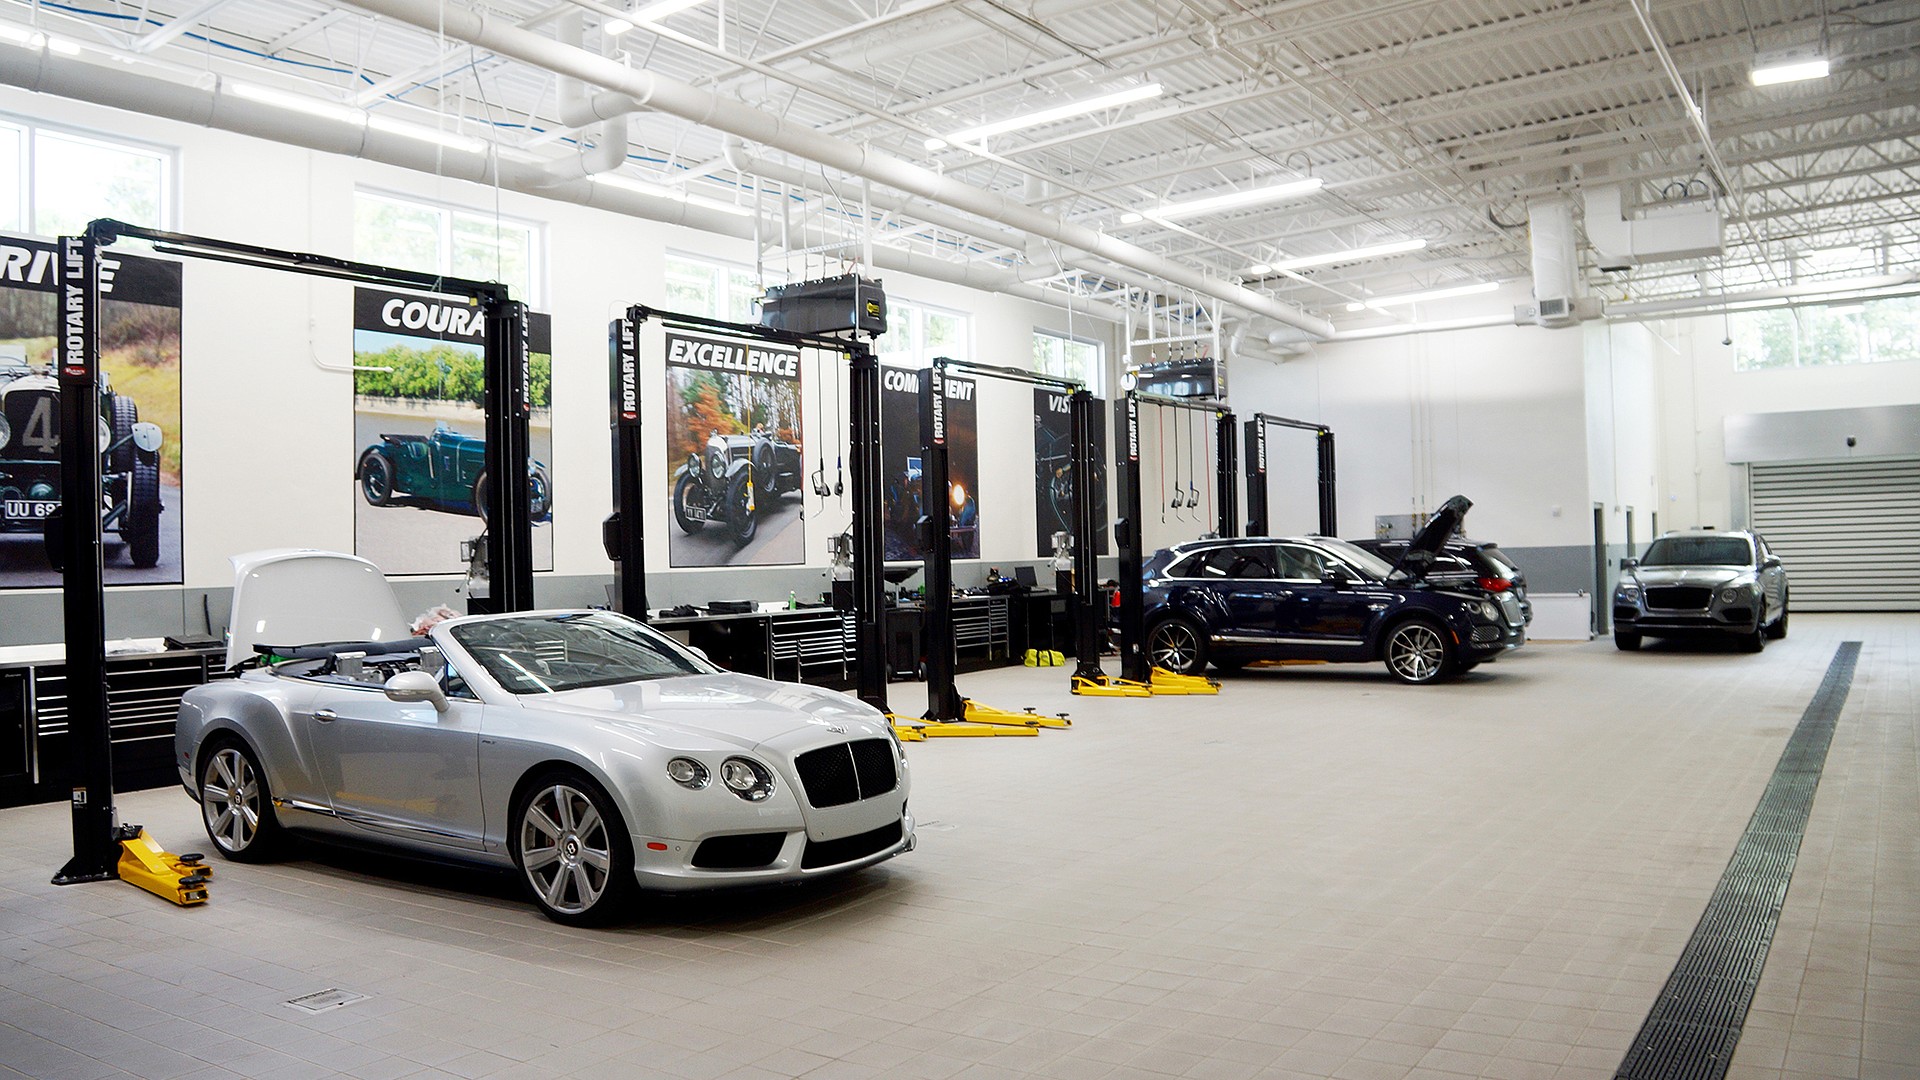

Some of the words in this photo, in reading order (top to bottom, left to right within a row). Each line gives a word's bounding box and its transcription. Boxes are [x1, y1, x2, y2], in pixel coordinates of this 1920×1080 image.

[0, 244, 122, 293] RIE
[66, 236, 84, 279] LIFT
[66, 284, 85, 365] ROTARY
[621, 318, 635, 350] LIFT
[668, 338, 799, 377] EXCELLENCE
[622, 352, 636, 412] ROTARY
[932, 366, 942, 391] LIFT
[22, 396, 61, 453] 4
[933, 392, 944, 439] ROTARY
[1048, 393, 1071, 415] VIS
[1128, 418, 1138, 456] ROTARY
[7, 502, 30, 517] UU
[34, 503, 62, 517] 69
